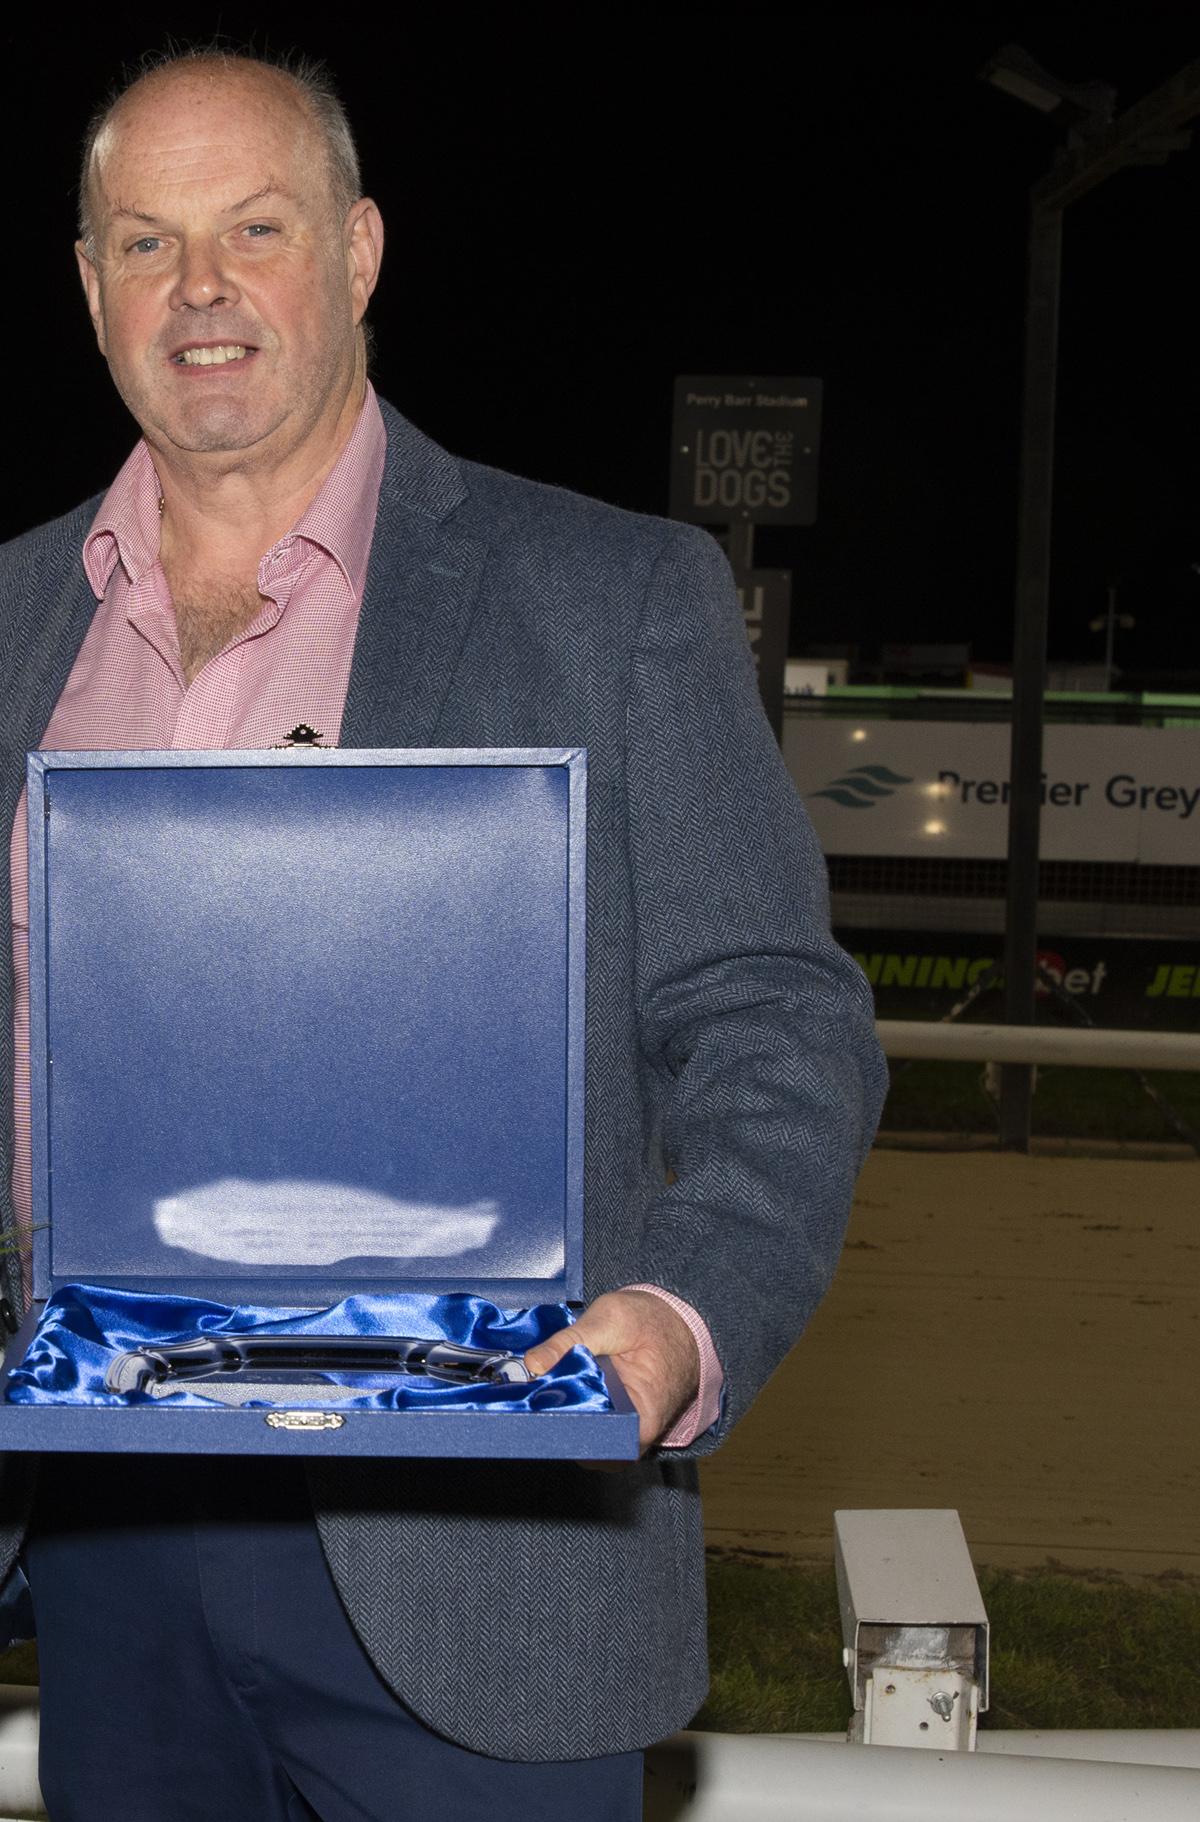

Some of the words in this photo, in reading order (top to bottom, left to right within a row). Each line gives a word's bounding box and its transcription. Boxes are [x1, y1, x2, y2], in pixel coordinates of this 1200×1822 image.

[696, 429, 773, 468] LOVE
[694, 468, 791, 508] DOGS
[1106, 775, 1200, 819] Grey
